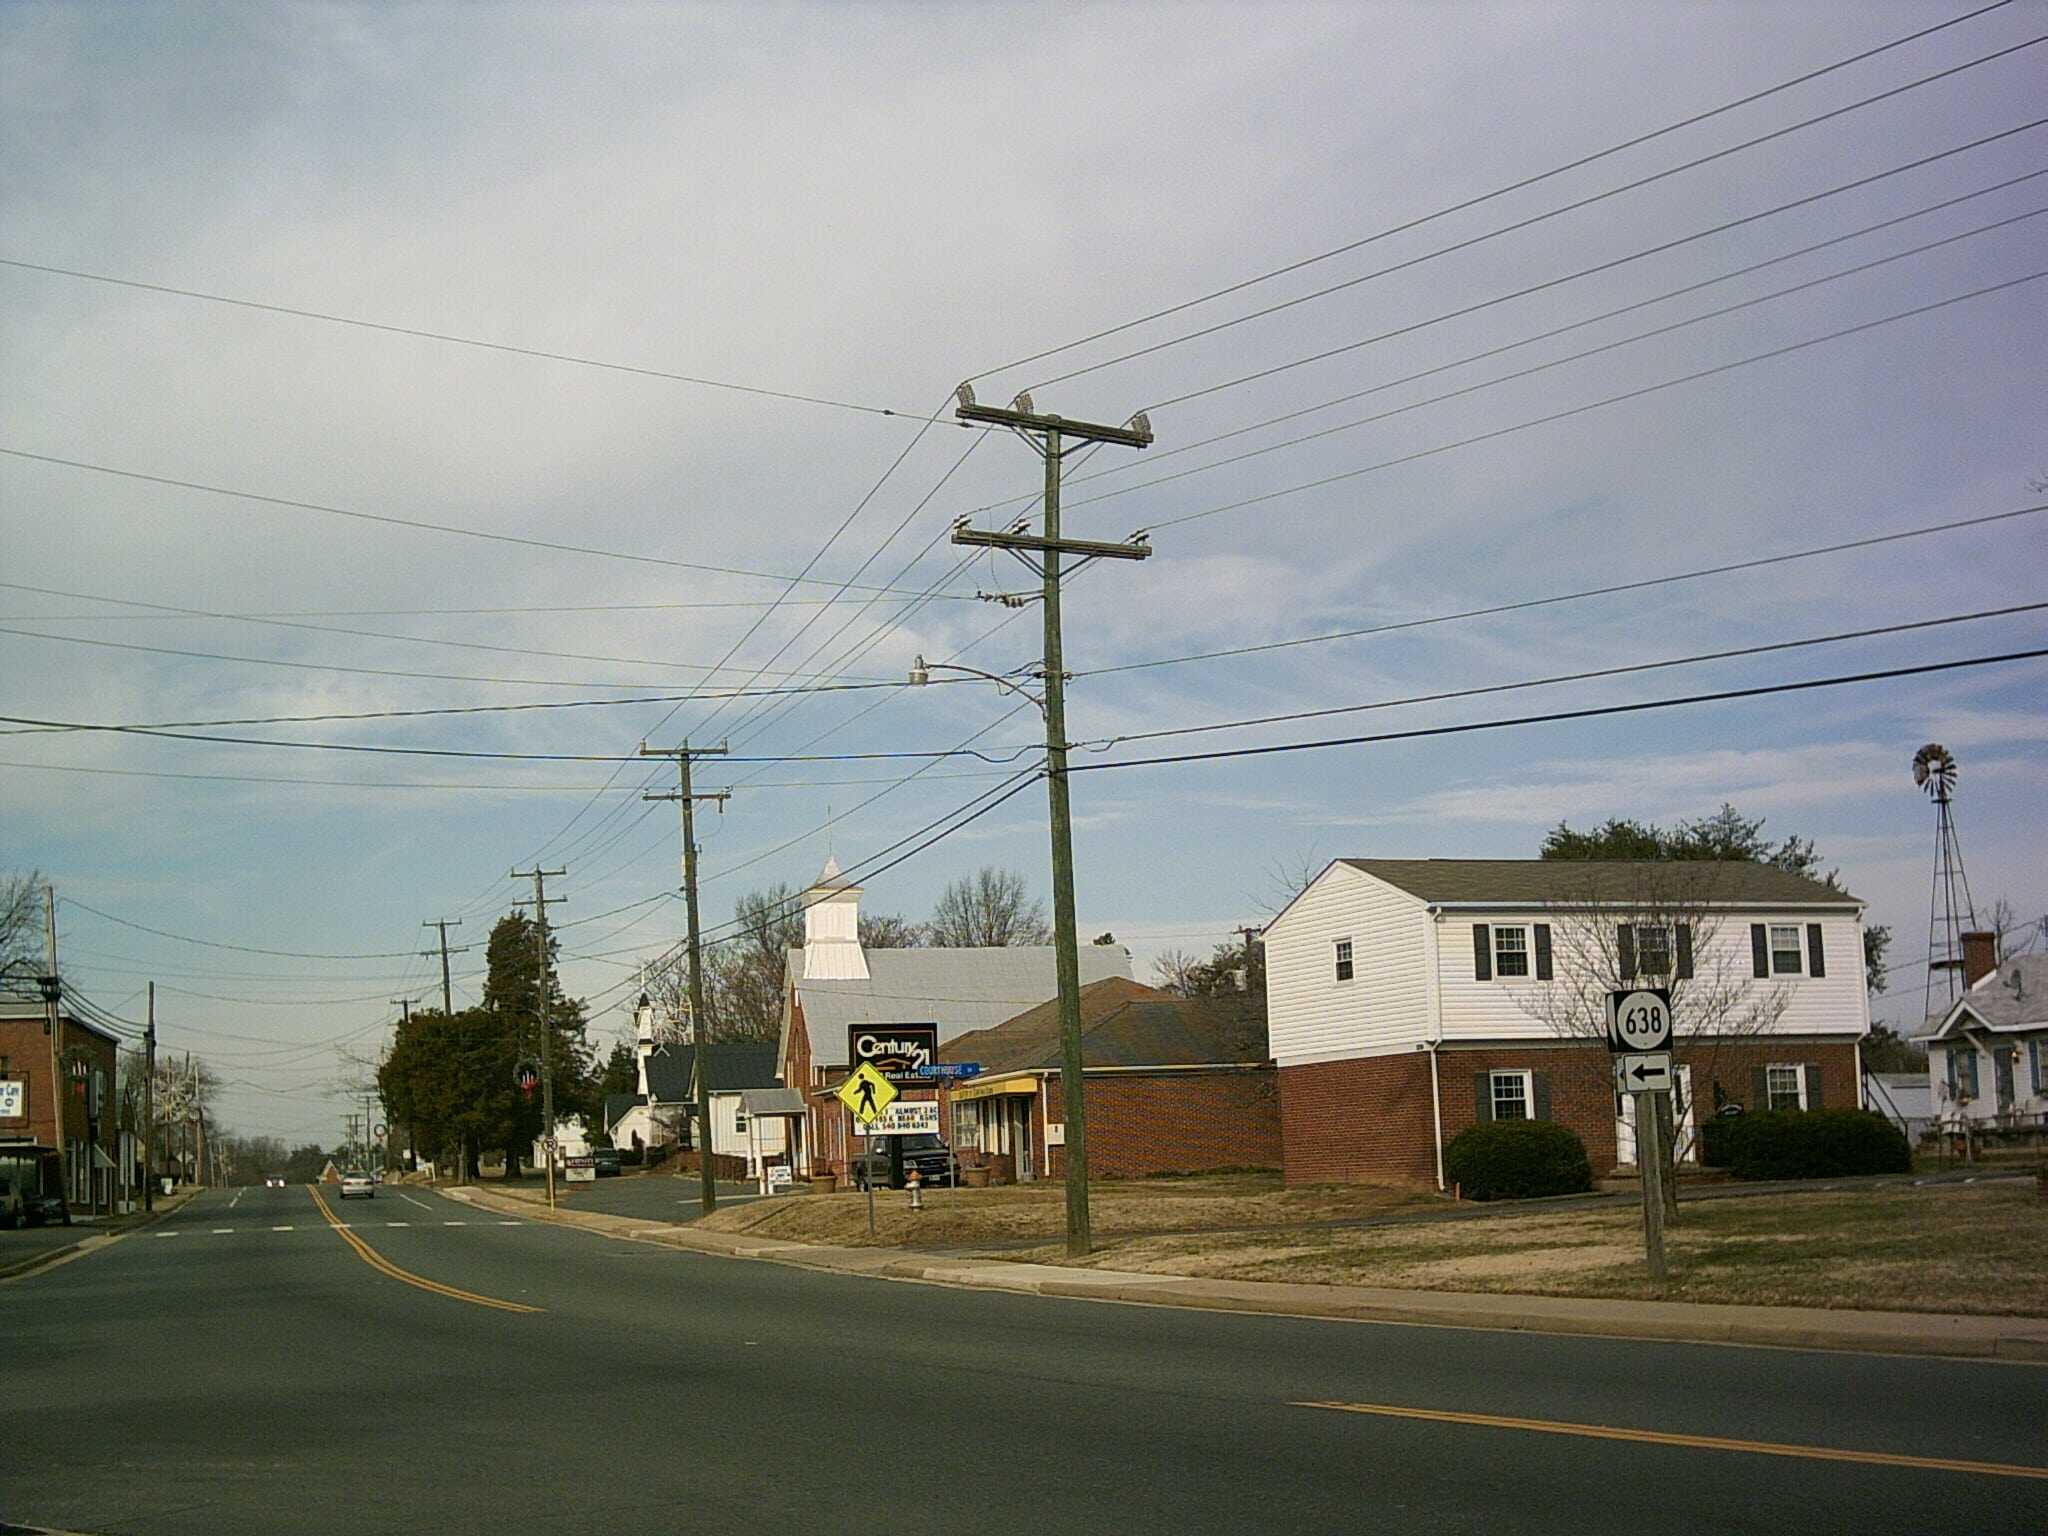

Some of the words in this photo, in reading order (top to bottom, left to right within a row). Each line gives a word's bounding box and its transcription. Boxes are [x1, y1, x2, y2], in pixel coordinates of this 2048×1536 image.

[1626, 1006, 1662, 1034] 638
[857, 1035, 919, 1058] Century
[912, 1048, 930, 1070] 21
[885, 1071, 903, 1079] Real
